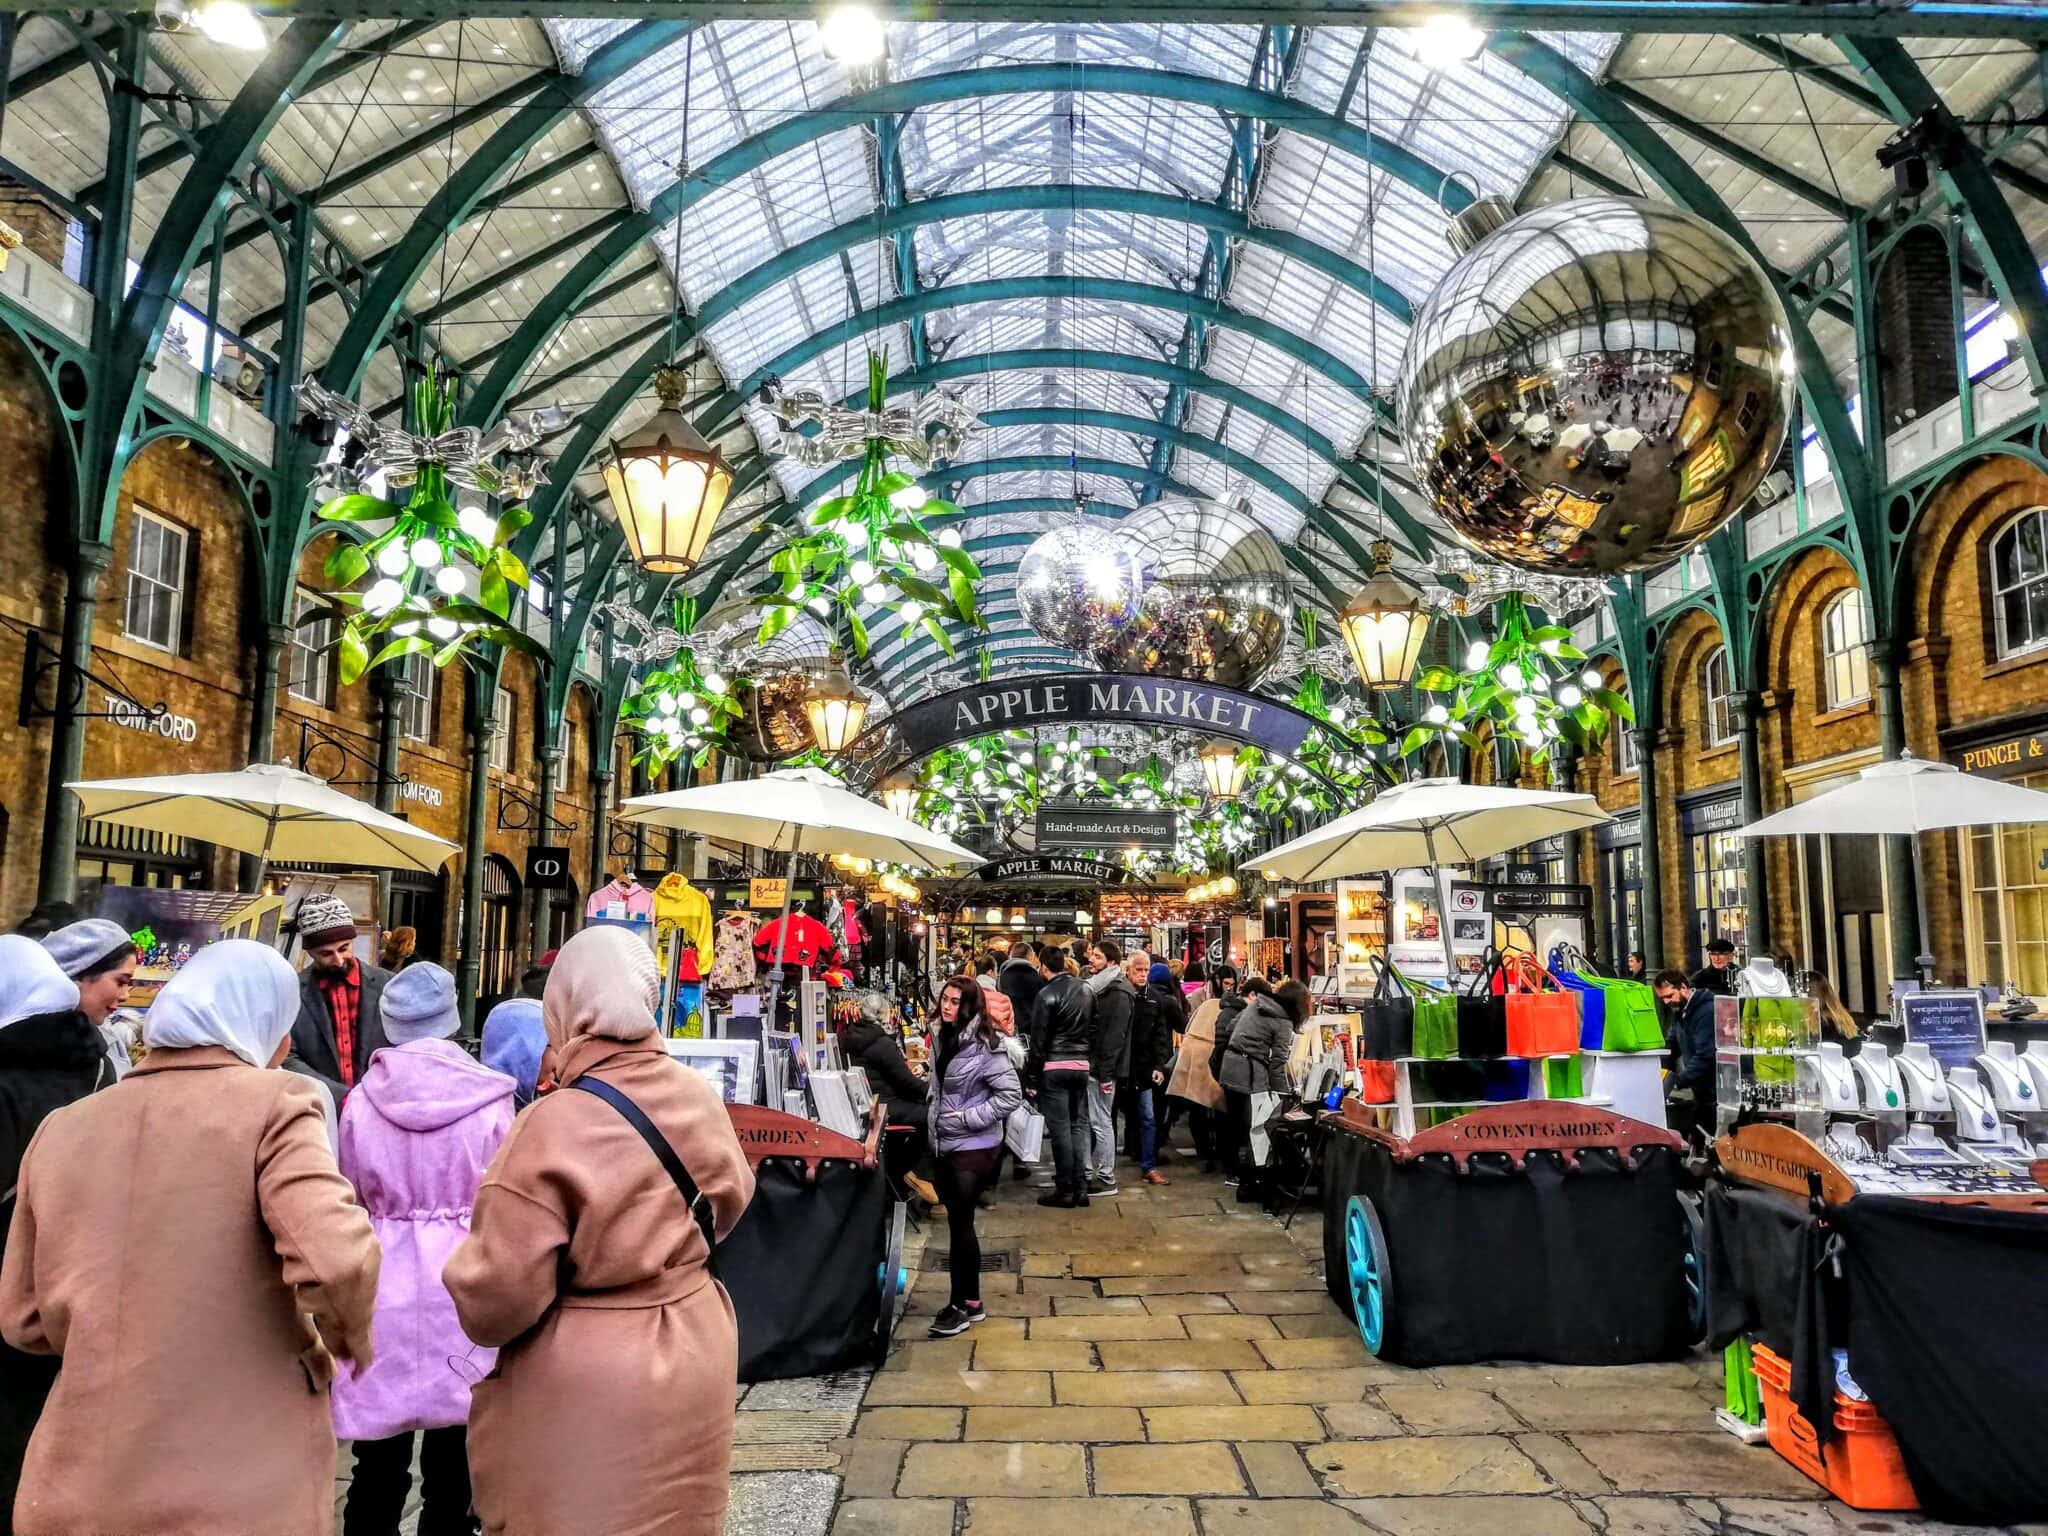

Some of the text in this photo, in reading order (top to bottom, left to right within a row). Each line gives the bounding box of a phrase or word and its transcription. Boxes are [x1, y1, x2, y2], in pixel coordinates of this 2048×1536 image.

[104, 695, 197, 742] TOM FORD
[954, 683, 1261, 732] APPLE MARKET
[1963, 738, 2043, 771] PUNCH &
[418, 784, 442, 807] FORD
[1045, 822, 1167, 836] Hand-made Art & Design
[997, 859, 1114, 879] APPLE MARKET
[1464, 1122, 1615, 1139] COVENT GARDEN
[1733, 1145, 1821, 1180] COVENT GARD
